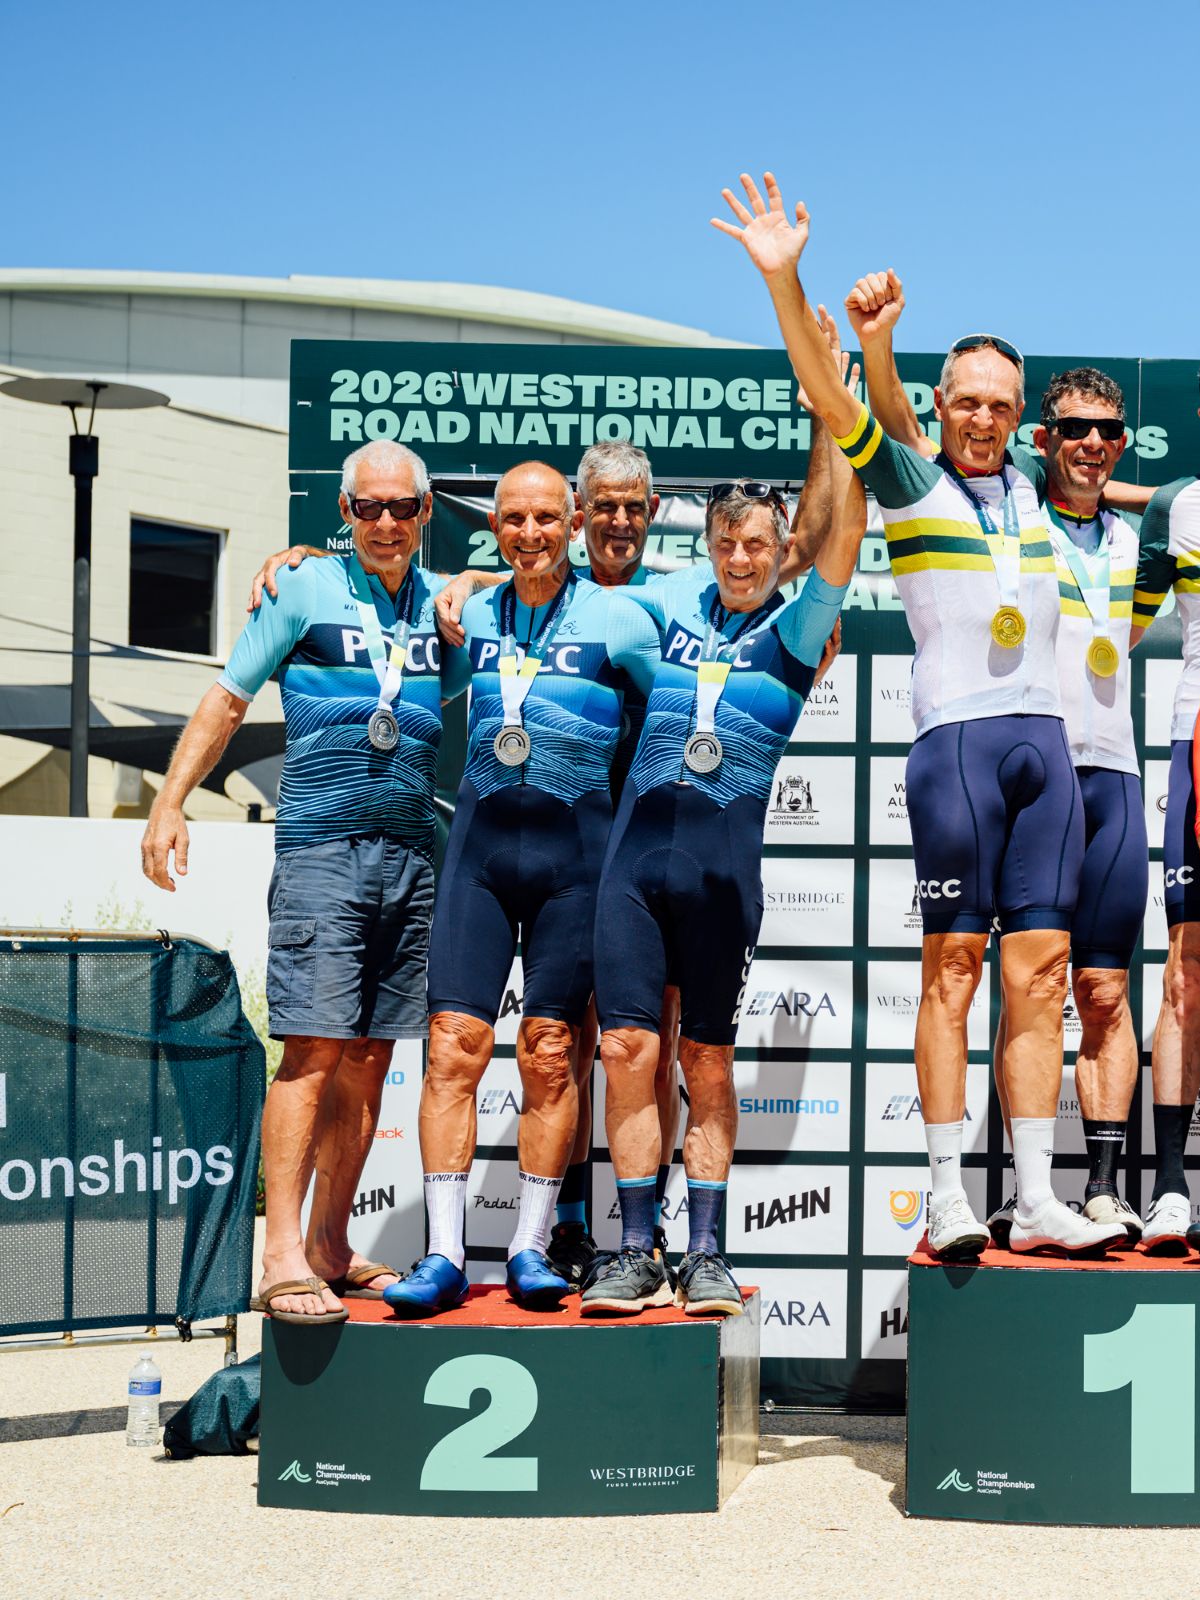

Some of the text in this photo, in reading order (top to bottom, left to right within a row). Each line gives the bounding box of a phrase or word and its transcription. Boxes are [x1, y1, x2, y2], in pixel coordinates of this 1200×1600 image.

[330, 369, 454, 406] 2026
[460, 372, 792, 412] WESTBRIDGE
[330, 409, 471, 443] ROAD
[479, 411, 735, 449] NATIONAL
[665, 629, 756, 669] PDC
[763, 892, 846, 904] STBRIDGE
[769, 991, 837, 1017] ARA
[739, 1098, 839, 1114] SHIMANO
[0, 1136, 234, 1204] onships
[660, 1195, 690, 1221] RA
[744, 1186, 831, 1233] HAHN
[763, 1300, 831, 1327] ARA
[1083, 1303, 1196, 1494] 1
[420, 1353, 539, 1491] 2
[316, 1462, 345, 1472] National
[316, 1470, 371, 1482] Championships
[590, 1465, 696, 1480] WESTBRIDGE
[977, 1470, 1008, 1480] National
[977, 1479, 1035, 1490] Championships
